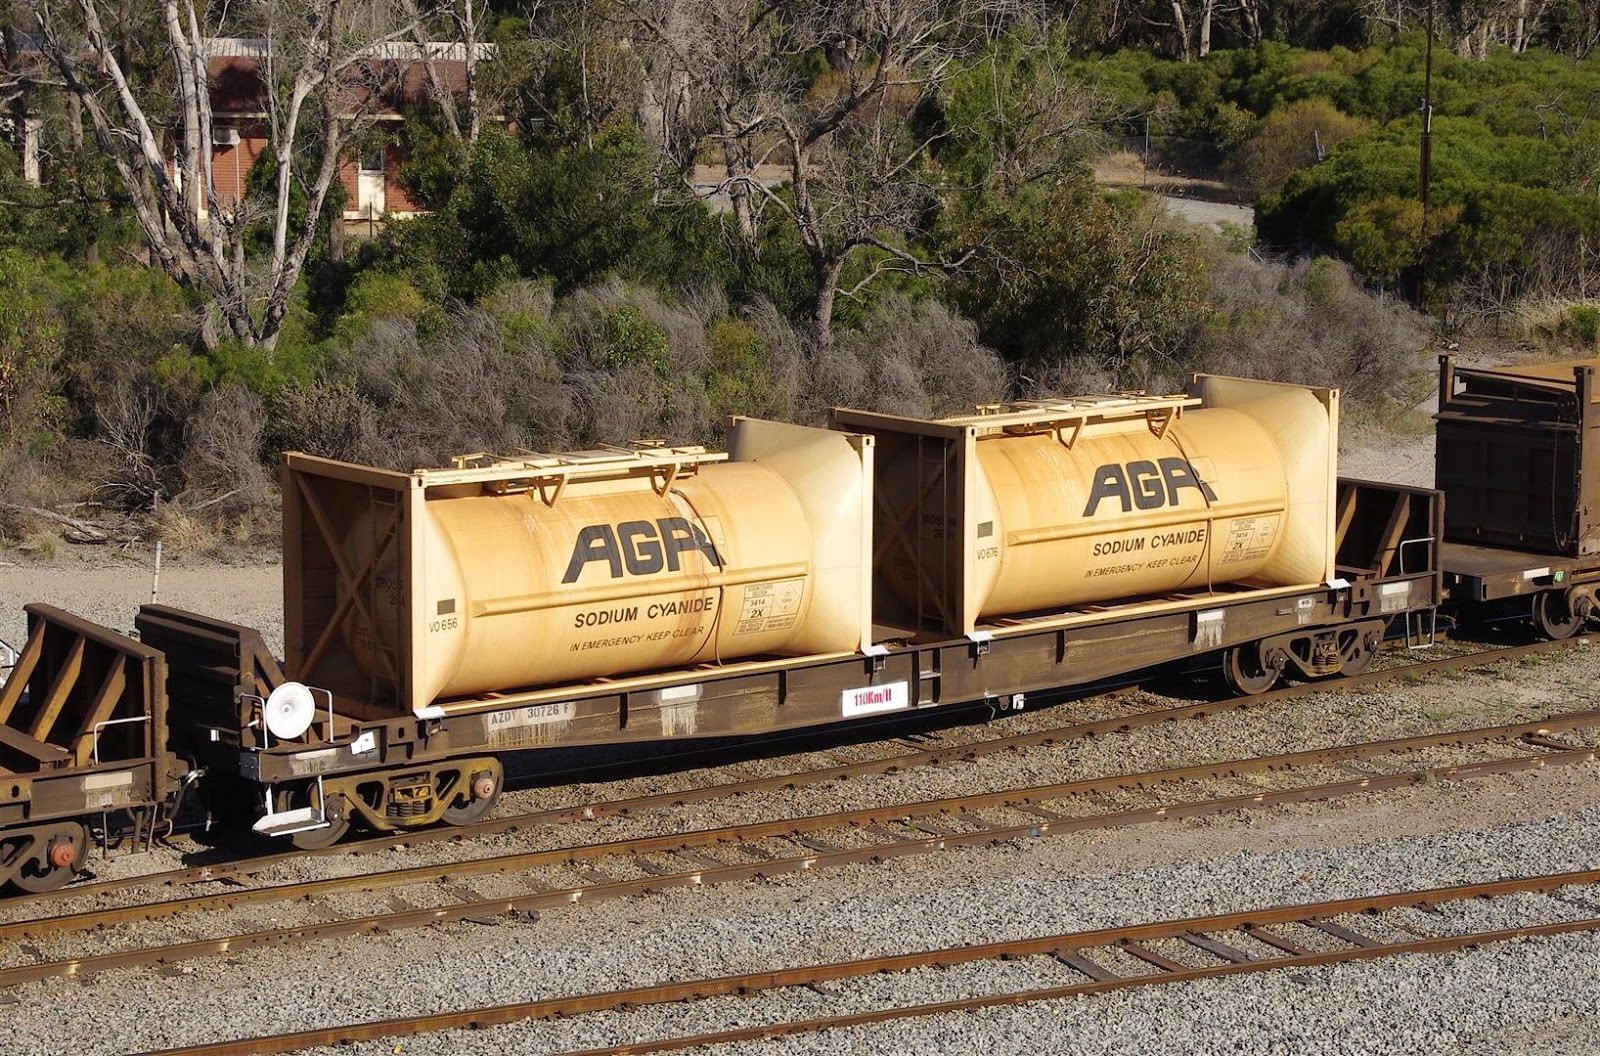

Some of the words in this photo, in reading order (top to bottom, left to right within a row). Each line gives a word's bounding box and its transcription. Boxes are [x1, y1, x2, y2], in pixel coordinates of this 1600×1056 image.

[561, 516, 727, 584] AGR
[1093, 537, 1145, 556] SODIUM
[1151, 529, 1205, 548] CYANIDE
[1232, 542, 1244, 550] 2X
[1085, 569, 1094, 578] IN
[1093, 562, 1146, 577] EMERGENCY
[1146, 559, 1169, 569] KEEP
[1169, 554, 1198, 566] CLEAR
[574, 606, 638, 628] SODIUM
[647, 597, 714, 619] CYANIDE
[750, 598, 765, 607] 3414
[750, 608, 764, 619] 2X
[569, 643, 580, 652] IN
[581, 634, 645, 651] EMERGENCY
[645, 630, 671, 642] KEEP
[672, 625, 705, 639] CLEAR
[527, 704, 560, 719] 30726
[563, 703, 570, 714] F
